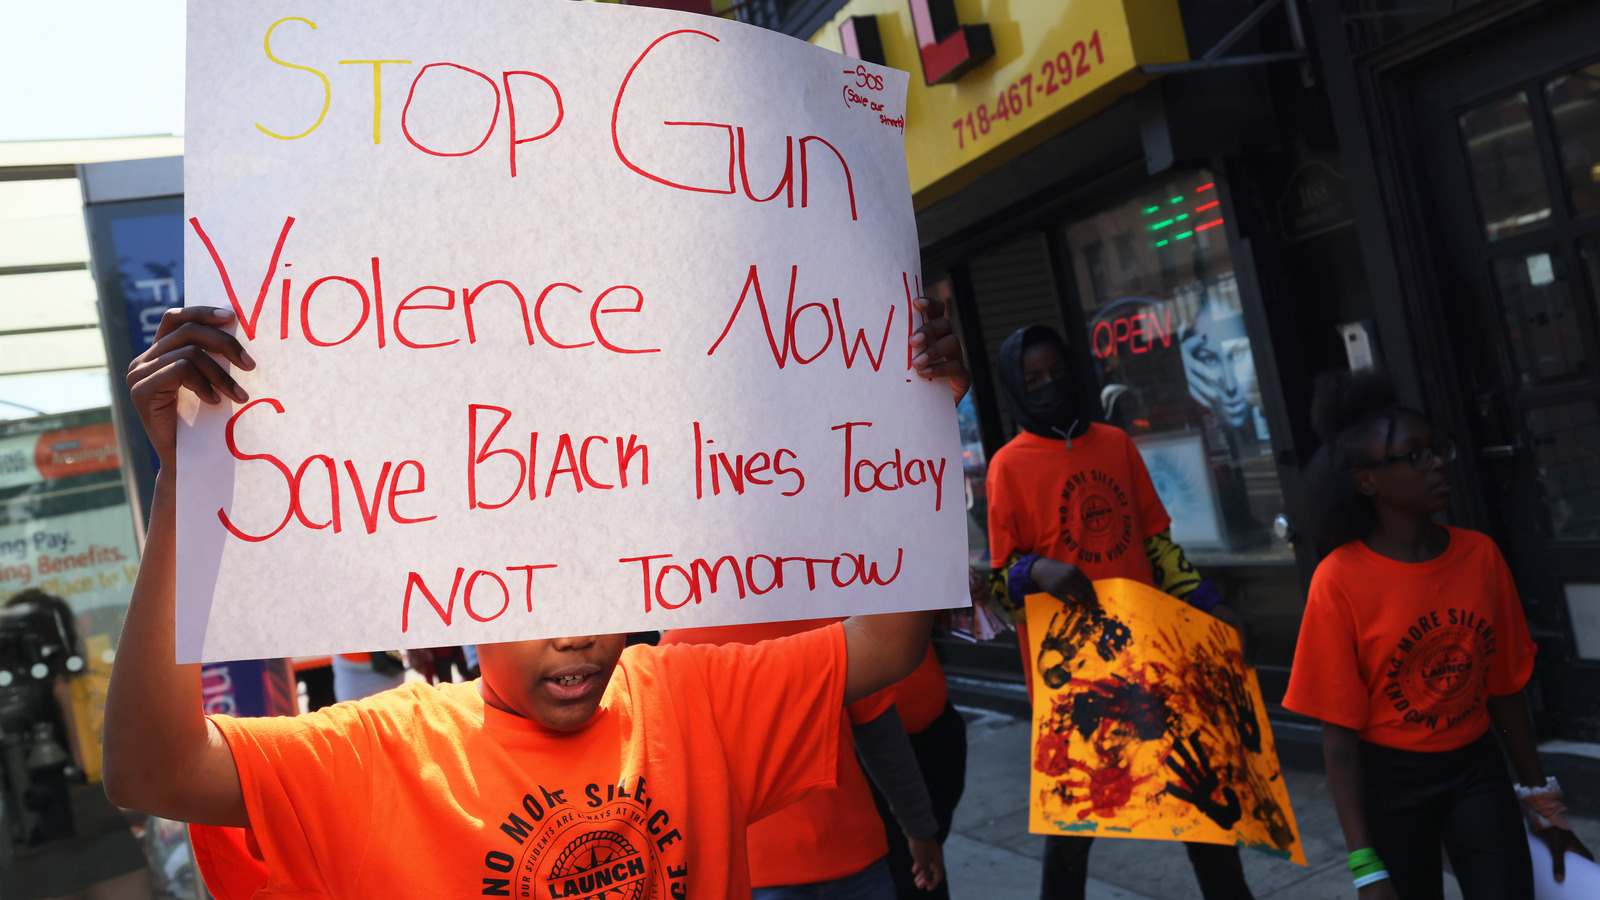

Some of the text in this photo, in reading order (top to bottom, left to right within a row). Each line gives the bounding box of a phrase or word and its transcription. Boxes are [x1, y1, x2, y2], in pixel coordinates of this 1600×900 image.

[953, 30, 1105, 149] 718-467-2921
[189, 216, 661, 353] Violence
[1092, 310, 1171, 359] OPEN
[217, 398, 438, 543] Save
[831, 422, 946, 511] Today
[402, 564, 558, 633] NOT
[1397, 610, 1442, 654] MORE
[1447, 608, 1497, 657] SILENCE
[1421, 661, 1473, 679] LAUNCH
[556, 812, 575, 829] ARE
[615, 807, 627, 816] AT
[630, 811, 646, 827] THE
[525, 826, 556, 873] STUDENTS
[482, 850, 515, 897] NO
[521, 876, 531, 898] OUR
[547, 857, 646, 900] LAUNCH
